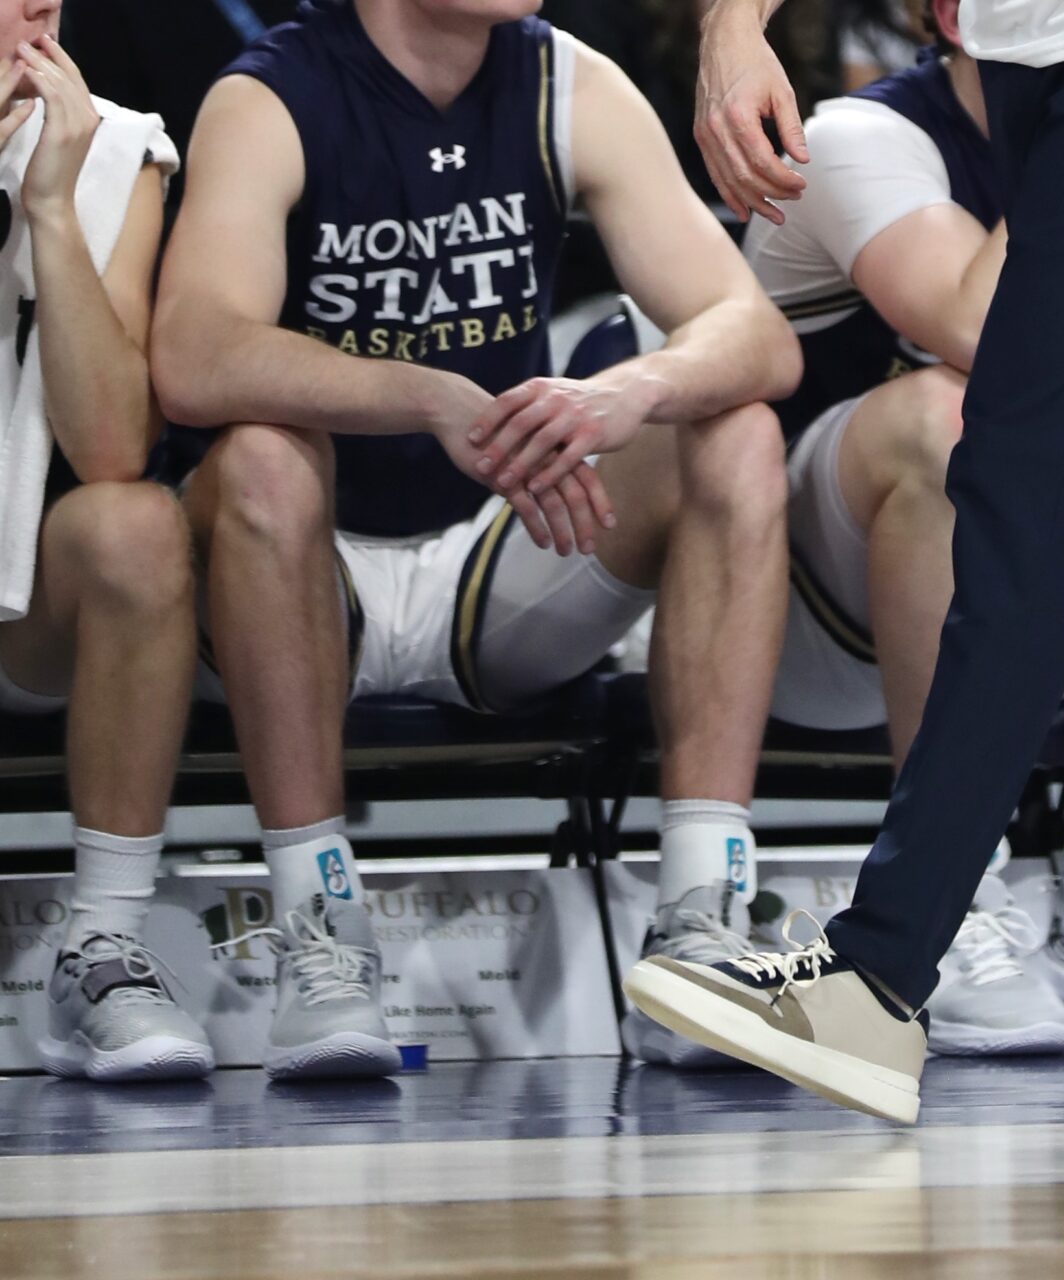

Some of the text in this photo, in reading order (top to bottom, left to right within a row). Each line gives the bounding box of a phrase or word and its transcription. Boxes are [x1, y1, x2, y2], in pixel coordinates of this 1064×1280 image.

[312, 192, 533, 264] MONAN
[2, 979, 45, 992] Mold
[236, 975, 277, 987] Wate
[478, 970, 521, 982] Mold
[384, 1003, 496, 1020] Like Home Again
